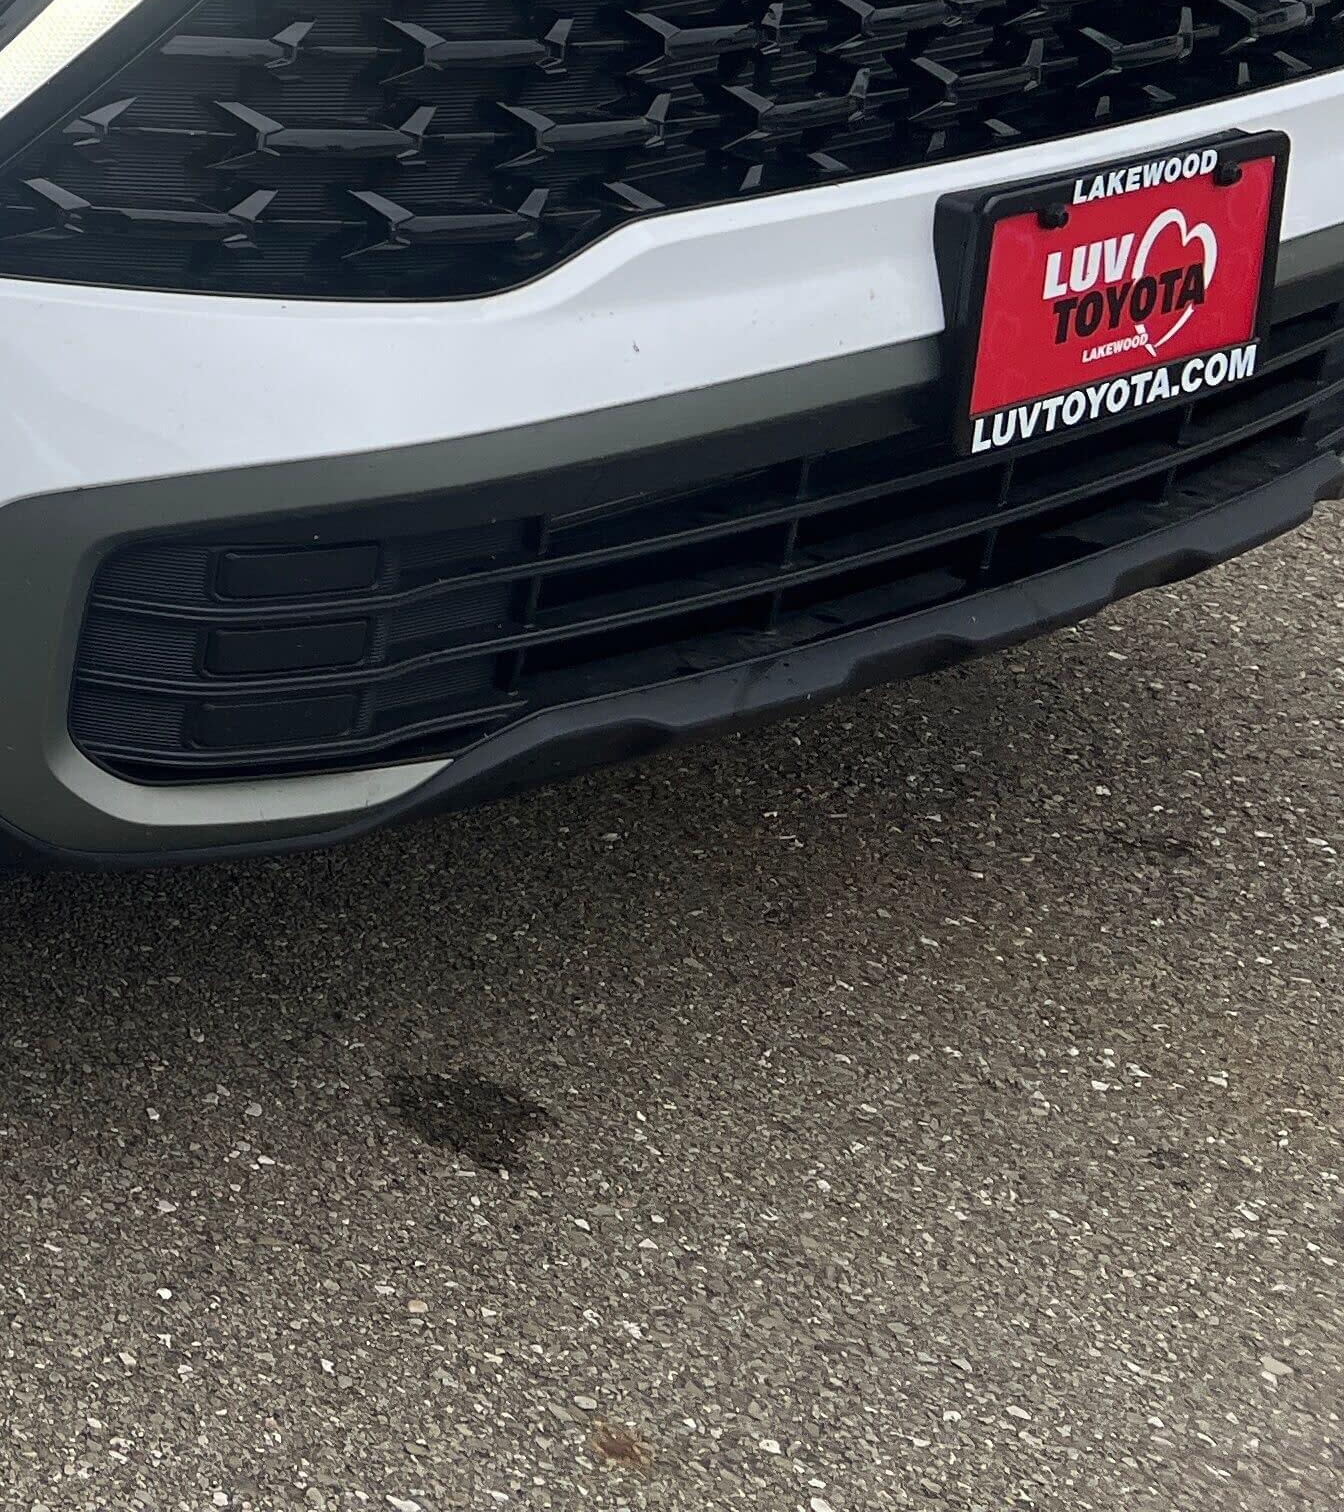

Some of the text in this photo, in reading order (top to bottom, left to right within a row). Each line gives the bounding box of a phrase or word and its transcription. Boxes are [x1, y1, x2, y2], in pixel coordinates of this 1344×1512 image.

[1072, 149, 1218, 204] LAKEWOOD
[1043, 233, 1136, 300] LUV
[1053, 263, 1206, 345] TOYOTA
[1082, 332, 1148, 363] LAKEWOOD
[971, 344, 1257, 454] LUVTOYOTA.COM
